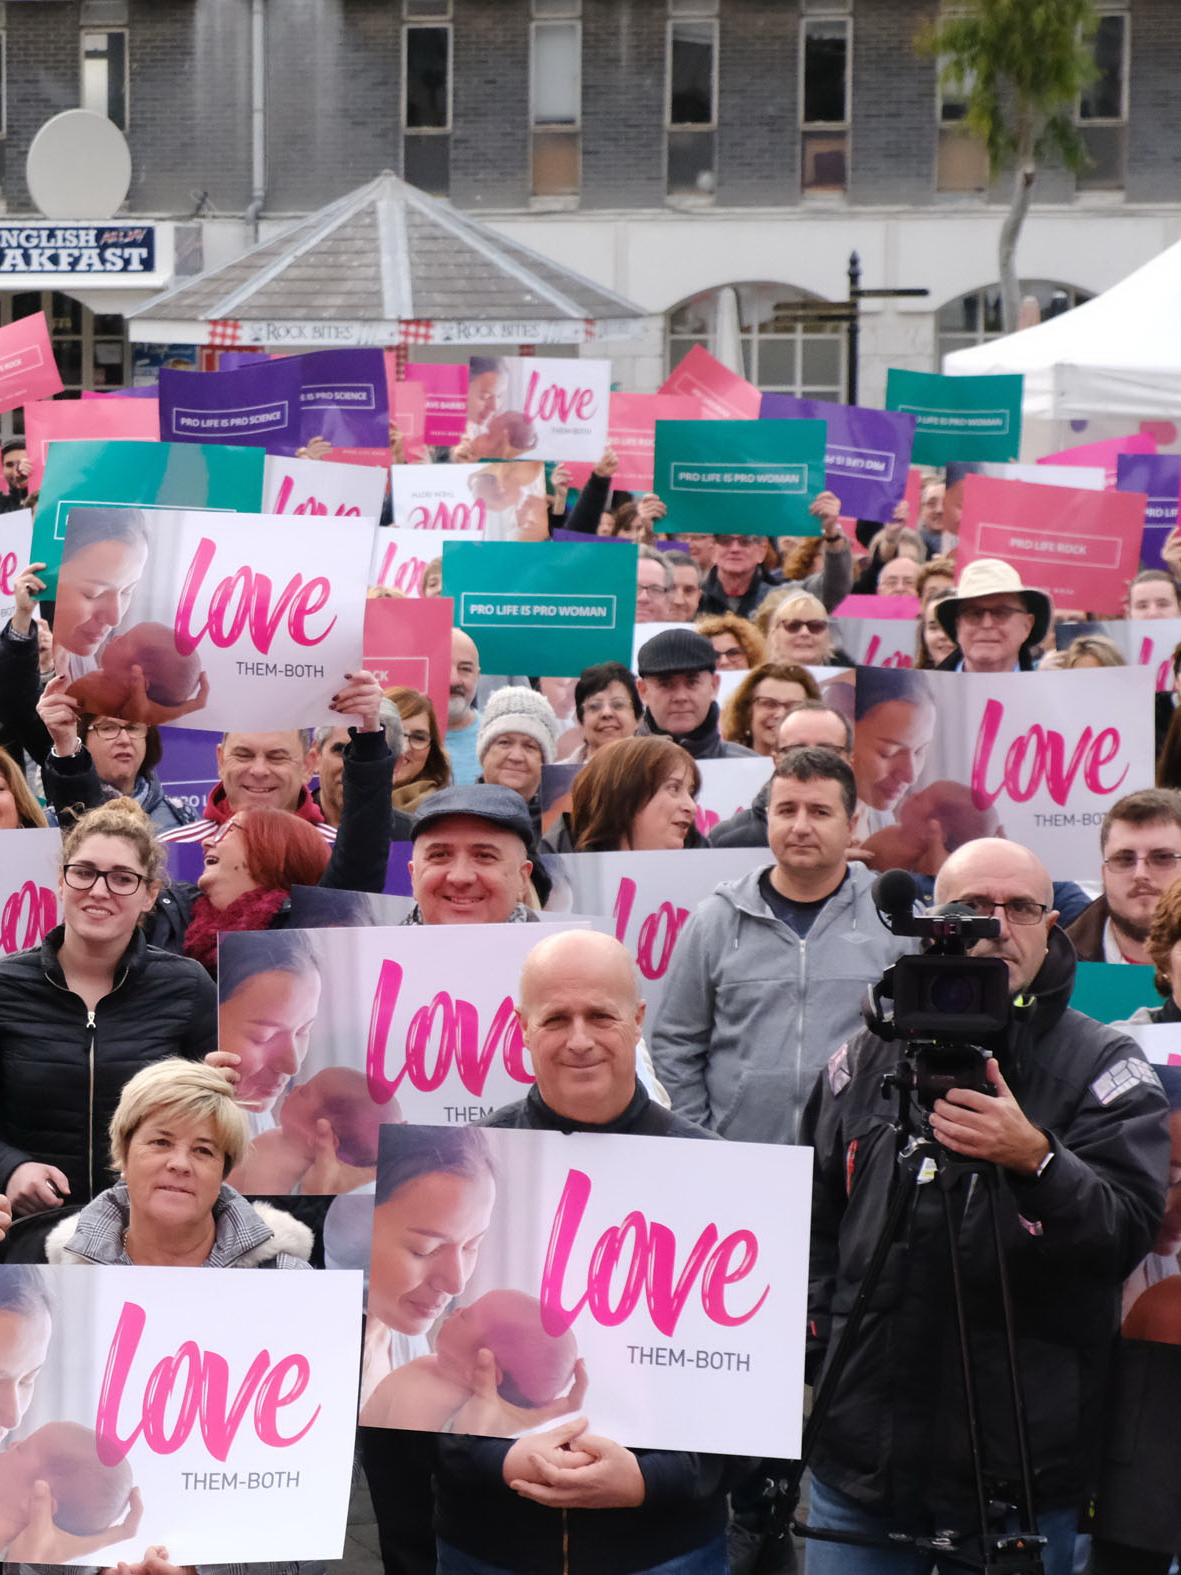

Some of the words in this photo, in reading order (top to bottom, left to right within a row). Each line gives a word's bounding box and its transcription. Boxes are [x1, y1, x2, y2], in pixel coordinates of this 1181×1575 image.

[268, 325, 306, 341] ROCK
[313, 326, 354, 340] BITES
[456, 323, 498, 339] ROCK
[502, 324, 540, 338] BITES
[316, 392, 333, 401] PRO
[334, 391, 367, 401] SCIENCE
[523, 370, 598, 425] love
[181, 417, 200, 427] PRO
[201, 418, 219, 428] LIFE
[220, 417, 229, 427] IS
[230, 416, 248, 426] PRO
[249, 411, 282, 424] SCIENCE
[679, 472, 699, 481] PRO
[702, 472, 721, 481] LIFE
[724, 473, 733, 482] IS
[734, 474, 755, 482] PRO
[757, 474, 800, 483] WOMAN
[1010, 538, 1033, 550] PRO
[1034, 541, 1054, 552] LIFE
[1057, 543, 1087, 554] ROCK
[174, 537, 338, 656] love
[470, 605, 494, 616] PRO
[496, 605, 519, 616] LIFE
[521, 606, 531, 616] IS
[532, 606, 557, 617] PRO
[558, 606, 607, 617] WOMAN
[236, 661, 325, 679] THEM-BOTH
[971, 699, 1130, 811] love
[1034, 813, 1106, 828] THEM-BO
[613, 877, 691, 980] lo
[540, 1168, 771, 1338] love
[627, 1345, 751, 1372] THEM-BOTH
[96, 1301, 322, 1467] love
[181, 1471, 300, 1491] THEM-BOTH
